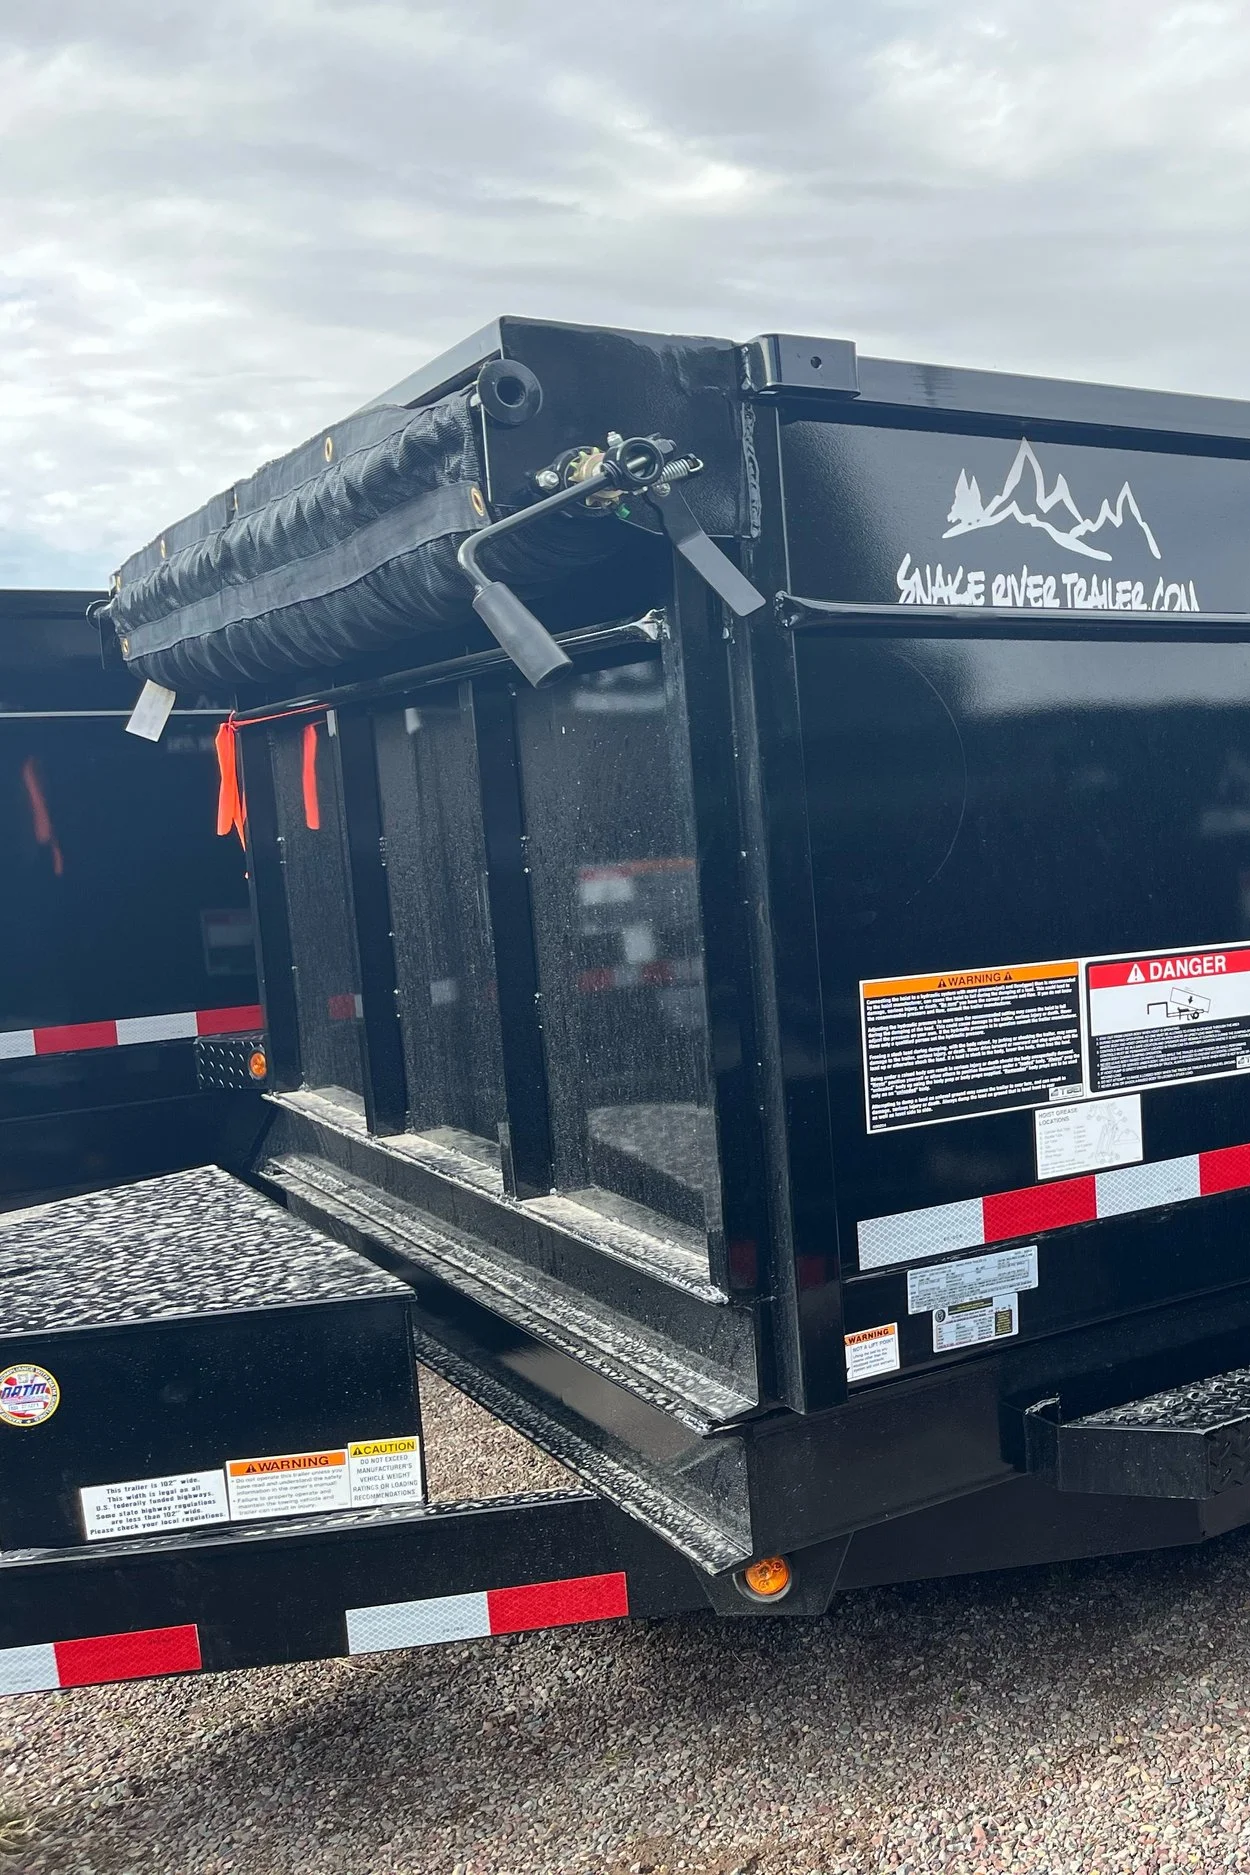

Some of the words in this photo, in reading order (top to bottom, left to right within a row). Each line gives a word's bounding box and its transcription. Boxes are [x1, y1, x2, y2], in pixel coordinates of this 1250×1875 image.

[897, 553, 986, 606] SNAKE
[992, 565, 1060, 608] RIVER
[1062, 572, 1200, 612] TRAILER.COM
[1149, 955, 1227, 981] DANGER
[948, 972, 1001, 986] WARNING
[1056, 1107, 1078, 1116] GREASE
[1038, 1115, 1070, 1126] LOCATIONS
[849, 1329, 889, 1344] WARNING
[363, 1440, 415, 1455] CAUTION
[257, 1455, 330, 1472] WARNING
[391, 1480, 417, 1488] LOADING
[177, 1492, 213, 1500] highways.
[355, 1490, 415, 1500] RECOMMENDATIONS
[175, 1500, 215, 1509] regulations
[182, 1513, 225, 1522] regulations.
